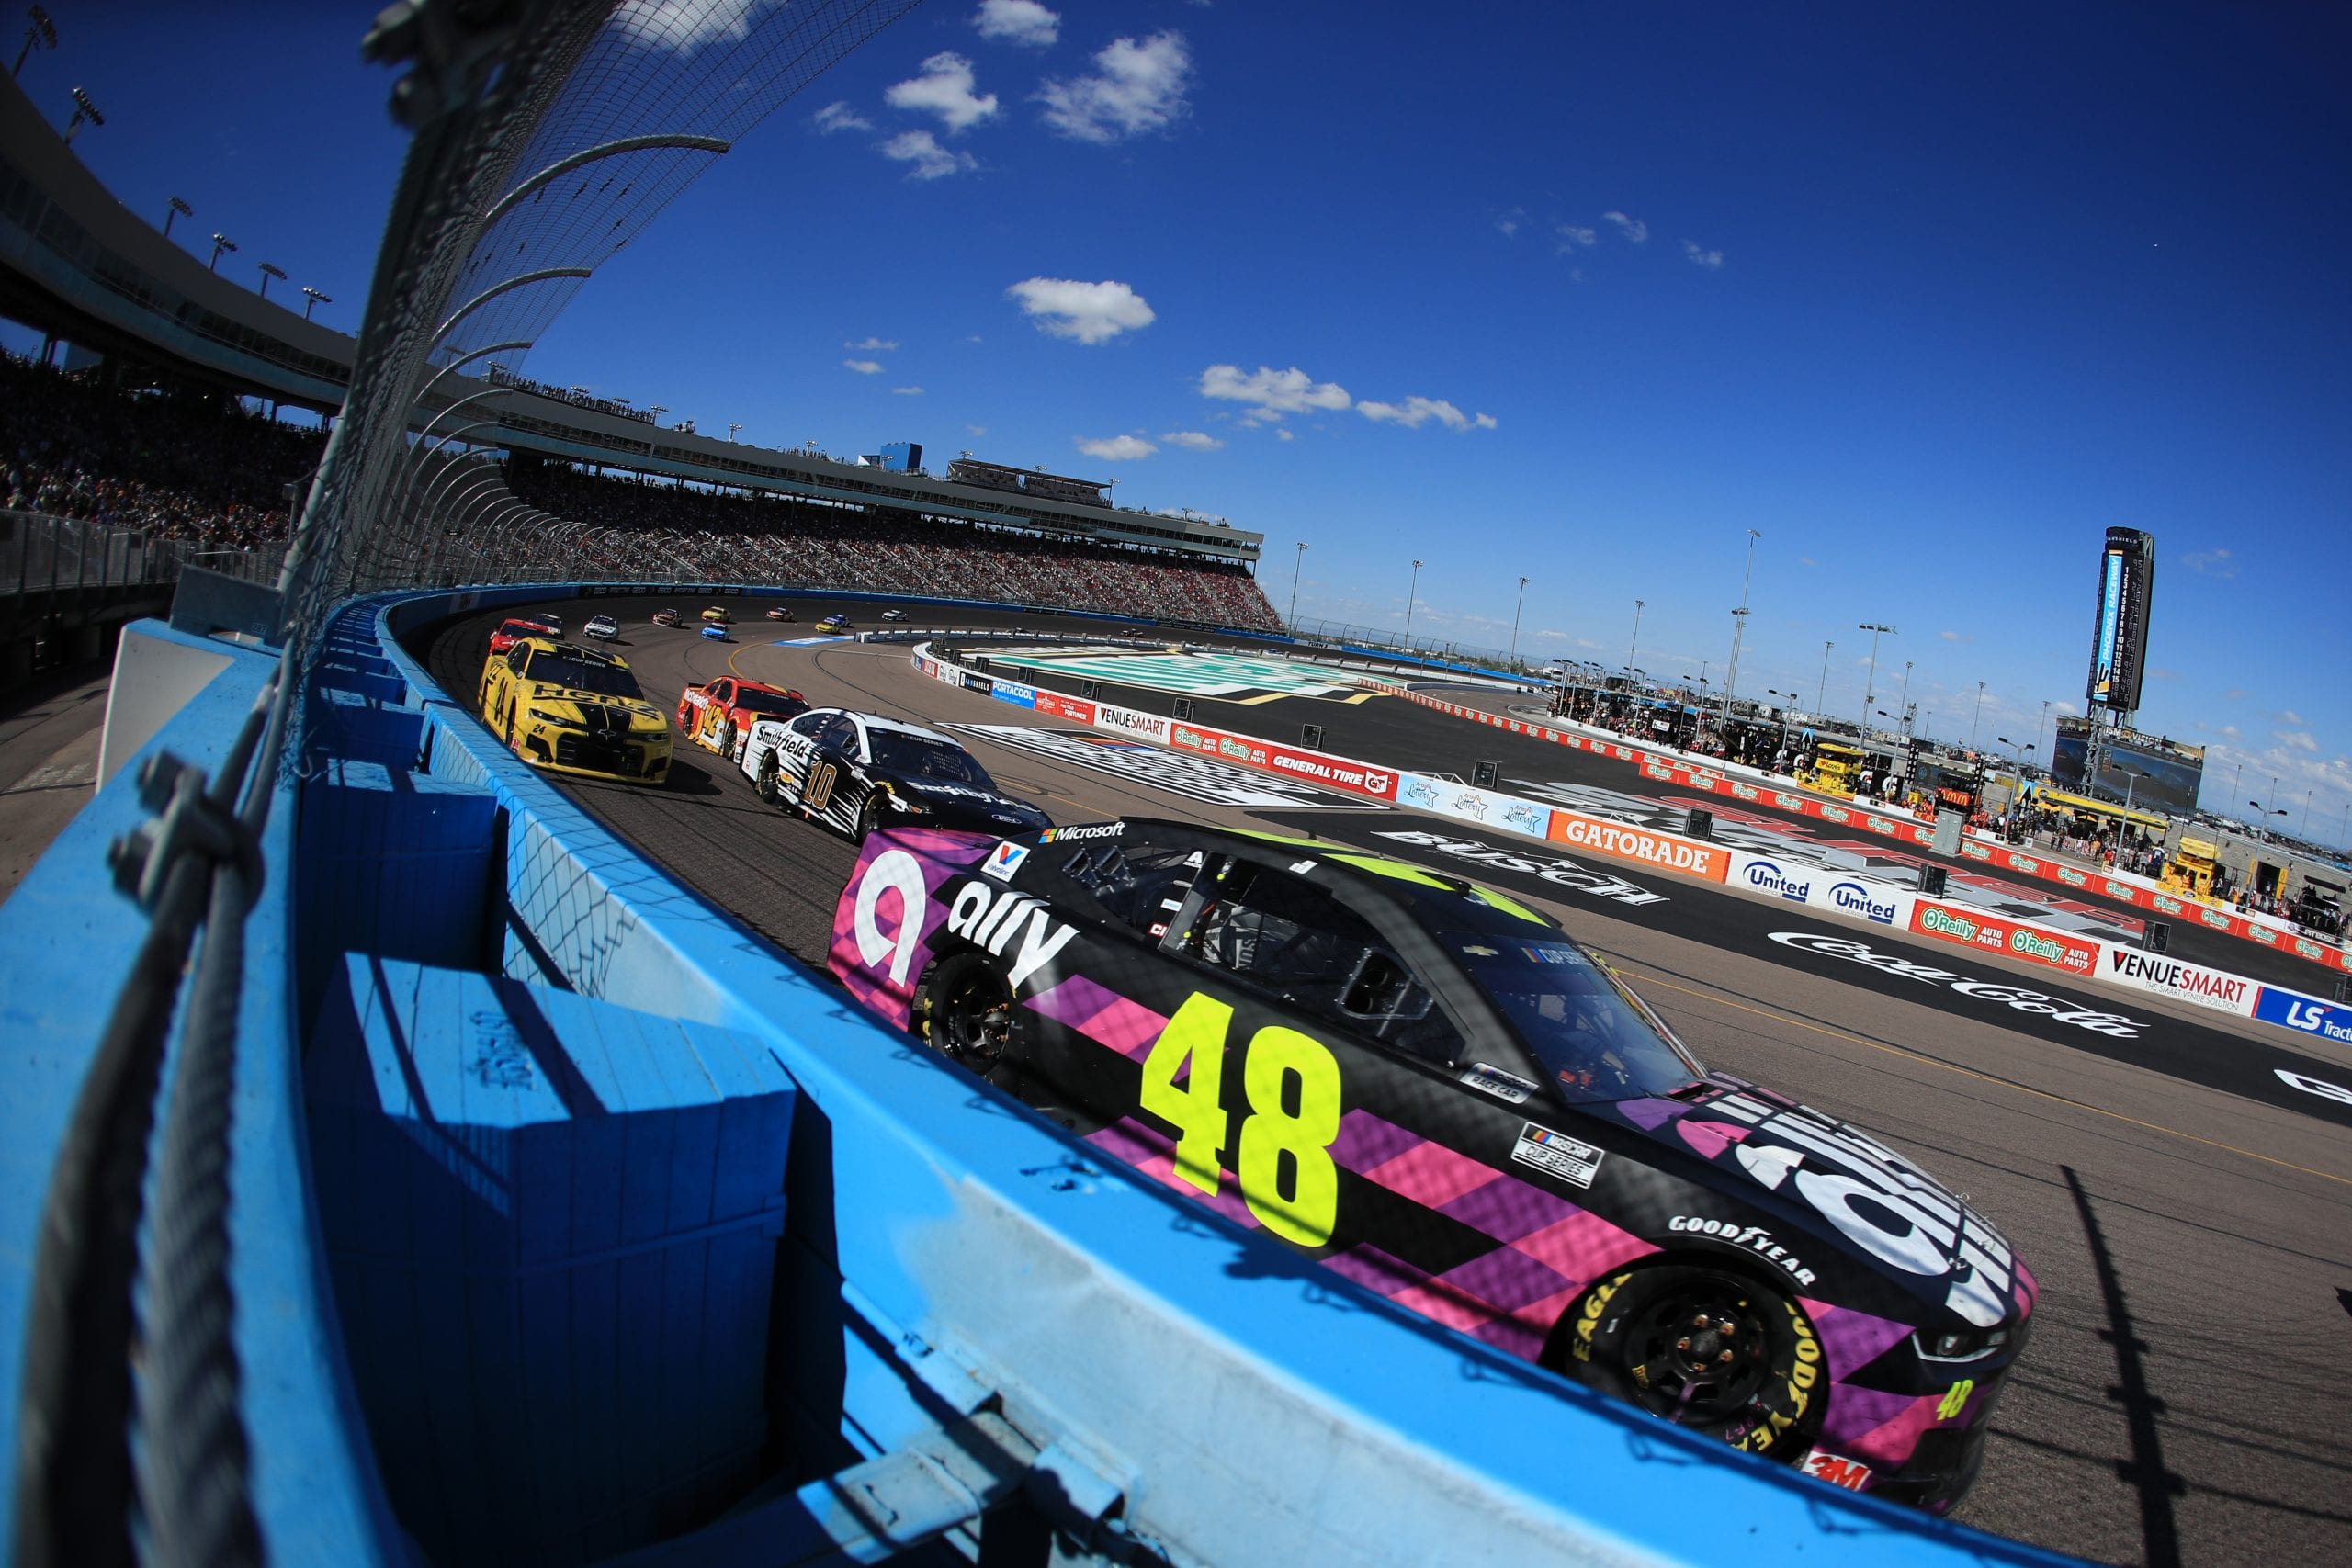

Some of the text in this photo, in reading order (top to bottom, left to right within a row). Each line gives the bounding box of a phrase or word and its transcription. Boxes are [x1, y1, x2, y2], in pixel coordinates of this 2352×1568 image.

[2102, 557, 2119, 660] PHOENIX RACEWAY
[584, 660, 606, 668] SERIES
[535, 684, 660, 714] Hertz
[993, 681, 1035, 701] PORTACOOL
[533, 724, 546, 735] 24
[704, 705, 722, 737] 42
[1101, 707, 1166, 736] VENUESMART
[1176, 728, 1202, 749] O'Reilly
[2106, 727, 2120, 737] ISM
[757, 726, 810, 759] Smithfield
[923, 739, 944, 748] SERIES
[1202, 743, 1216, 752] PARTS
[1204, 738, 1216, 748] AUTO
[1220, 739, 1250, 761] O'Reilly
[1251, 755, 1266, 764] PARTS
[1253, 750, 1266, 759] AUTO
[1273, 755, 1365, 786] GENERAL TIRE
[1648, 763, 1672, 779] O'Reilly
[1826, 762, 1841, 771] Love's
[801, 761, 838, 810] 10
[1689, 773, 1714, 788] O'Reilly
[1404, 784, 1431, 805] Lottery
[1733, 784, 1758, 798] O'Reilly
[1776, 794, 1803, 808] O'Reilly
[1451, 795, 1481, 816] Lottery
[1822, 806, 1849, 821] O'Reilly
[1501, 807, 1533, 829] Lottery
[1867, 818, 1894, 832] O'Reilly
[1056, 821, 1125, 841] Microsoft
[1566, 820, 1711, 874] GATORADE
[1962, 843, 1990, 859] O'Reilly
[987, 863, 1009, 876] Valvoline
[1369, 830, 1670, 906] BUSCH
[2009, 854, 2038, 871] O'Reilly
[1750, 869, 1810, 898] United
[2058, 867, 2086, 886] O'Reilly
[2106, 881, 2135, 899] O'Reilly
[1836, 891, 1896, 920] United
[2154, 897, 2183, 913] O'Reilly
[1923, 908, 1977, 940] O'Reilly
[2202, 909, 2231, 928] O'Reilly
[948, 881, 1080, 990] ally
[1977, 935, 2003, 948] PARTS
[1981, 927, 2003, 939] AUTO
[2249, 924, 2278, 942] O'Reilly
[2012, 930, 2065, 962] O'Reilly
[2068, 948, 2089, 961] AUTO
[2297, 940, 2324, 958] O'Reilly
[2064, 957, 2088, 970] PARTS
[1767, 931, 2152, 1038] Coca-Cola
[2113, 951, 2247, 1003] VENUESMART
[2144, 981, 2239, 1011] THE SMART VENUE SOLUTION
[2286, 1001, 2324, 1031] LS
[1472, 1077, 1519, 1099] RACE CAR
[1140, 991, 1341, 1247] 48
[1546, 1135, 1593, 1159] NASCAR
[1525, 1146, 1585, 1176] CUP SERIES
[1668, 1215, 1817, 1286] GOODYEAR
[1937, 1380, 1974, 1420] 48
[1810, 1456, 1871, 1491] 3M
